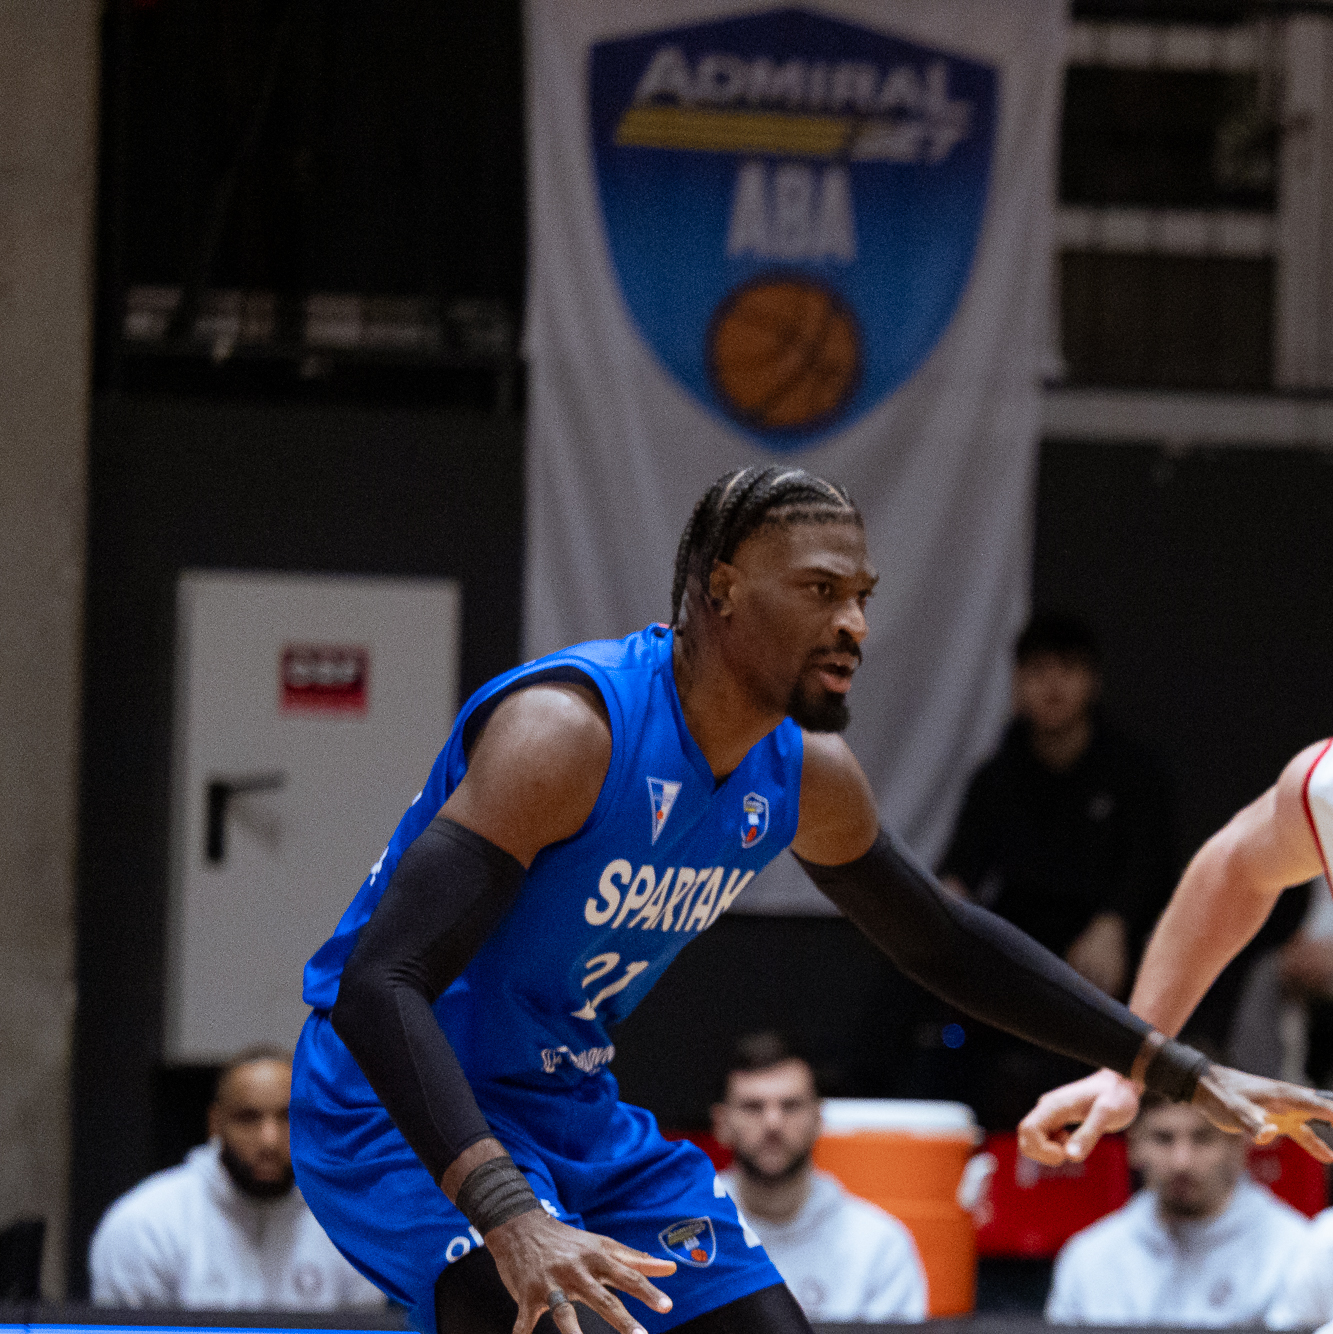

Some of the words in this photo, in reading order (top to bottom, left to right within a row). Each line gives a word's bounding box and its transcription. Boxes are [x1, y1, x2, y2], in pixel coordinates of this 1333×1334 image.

[632, 44, 972, 120] ADMIRAL
[725, 161, 858, 263] ABA
[584, 858, 755, 932] SPARTAK
[570, 951, 649, 1021] 21
